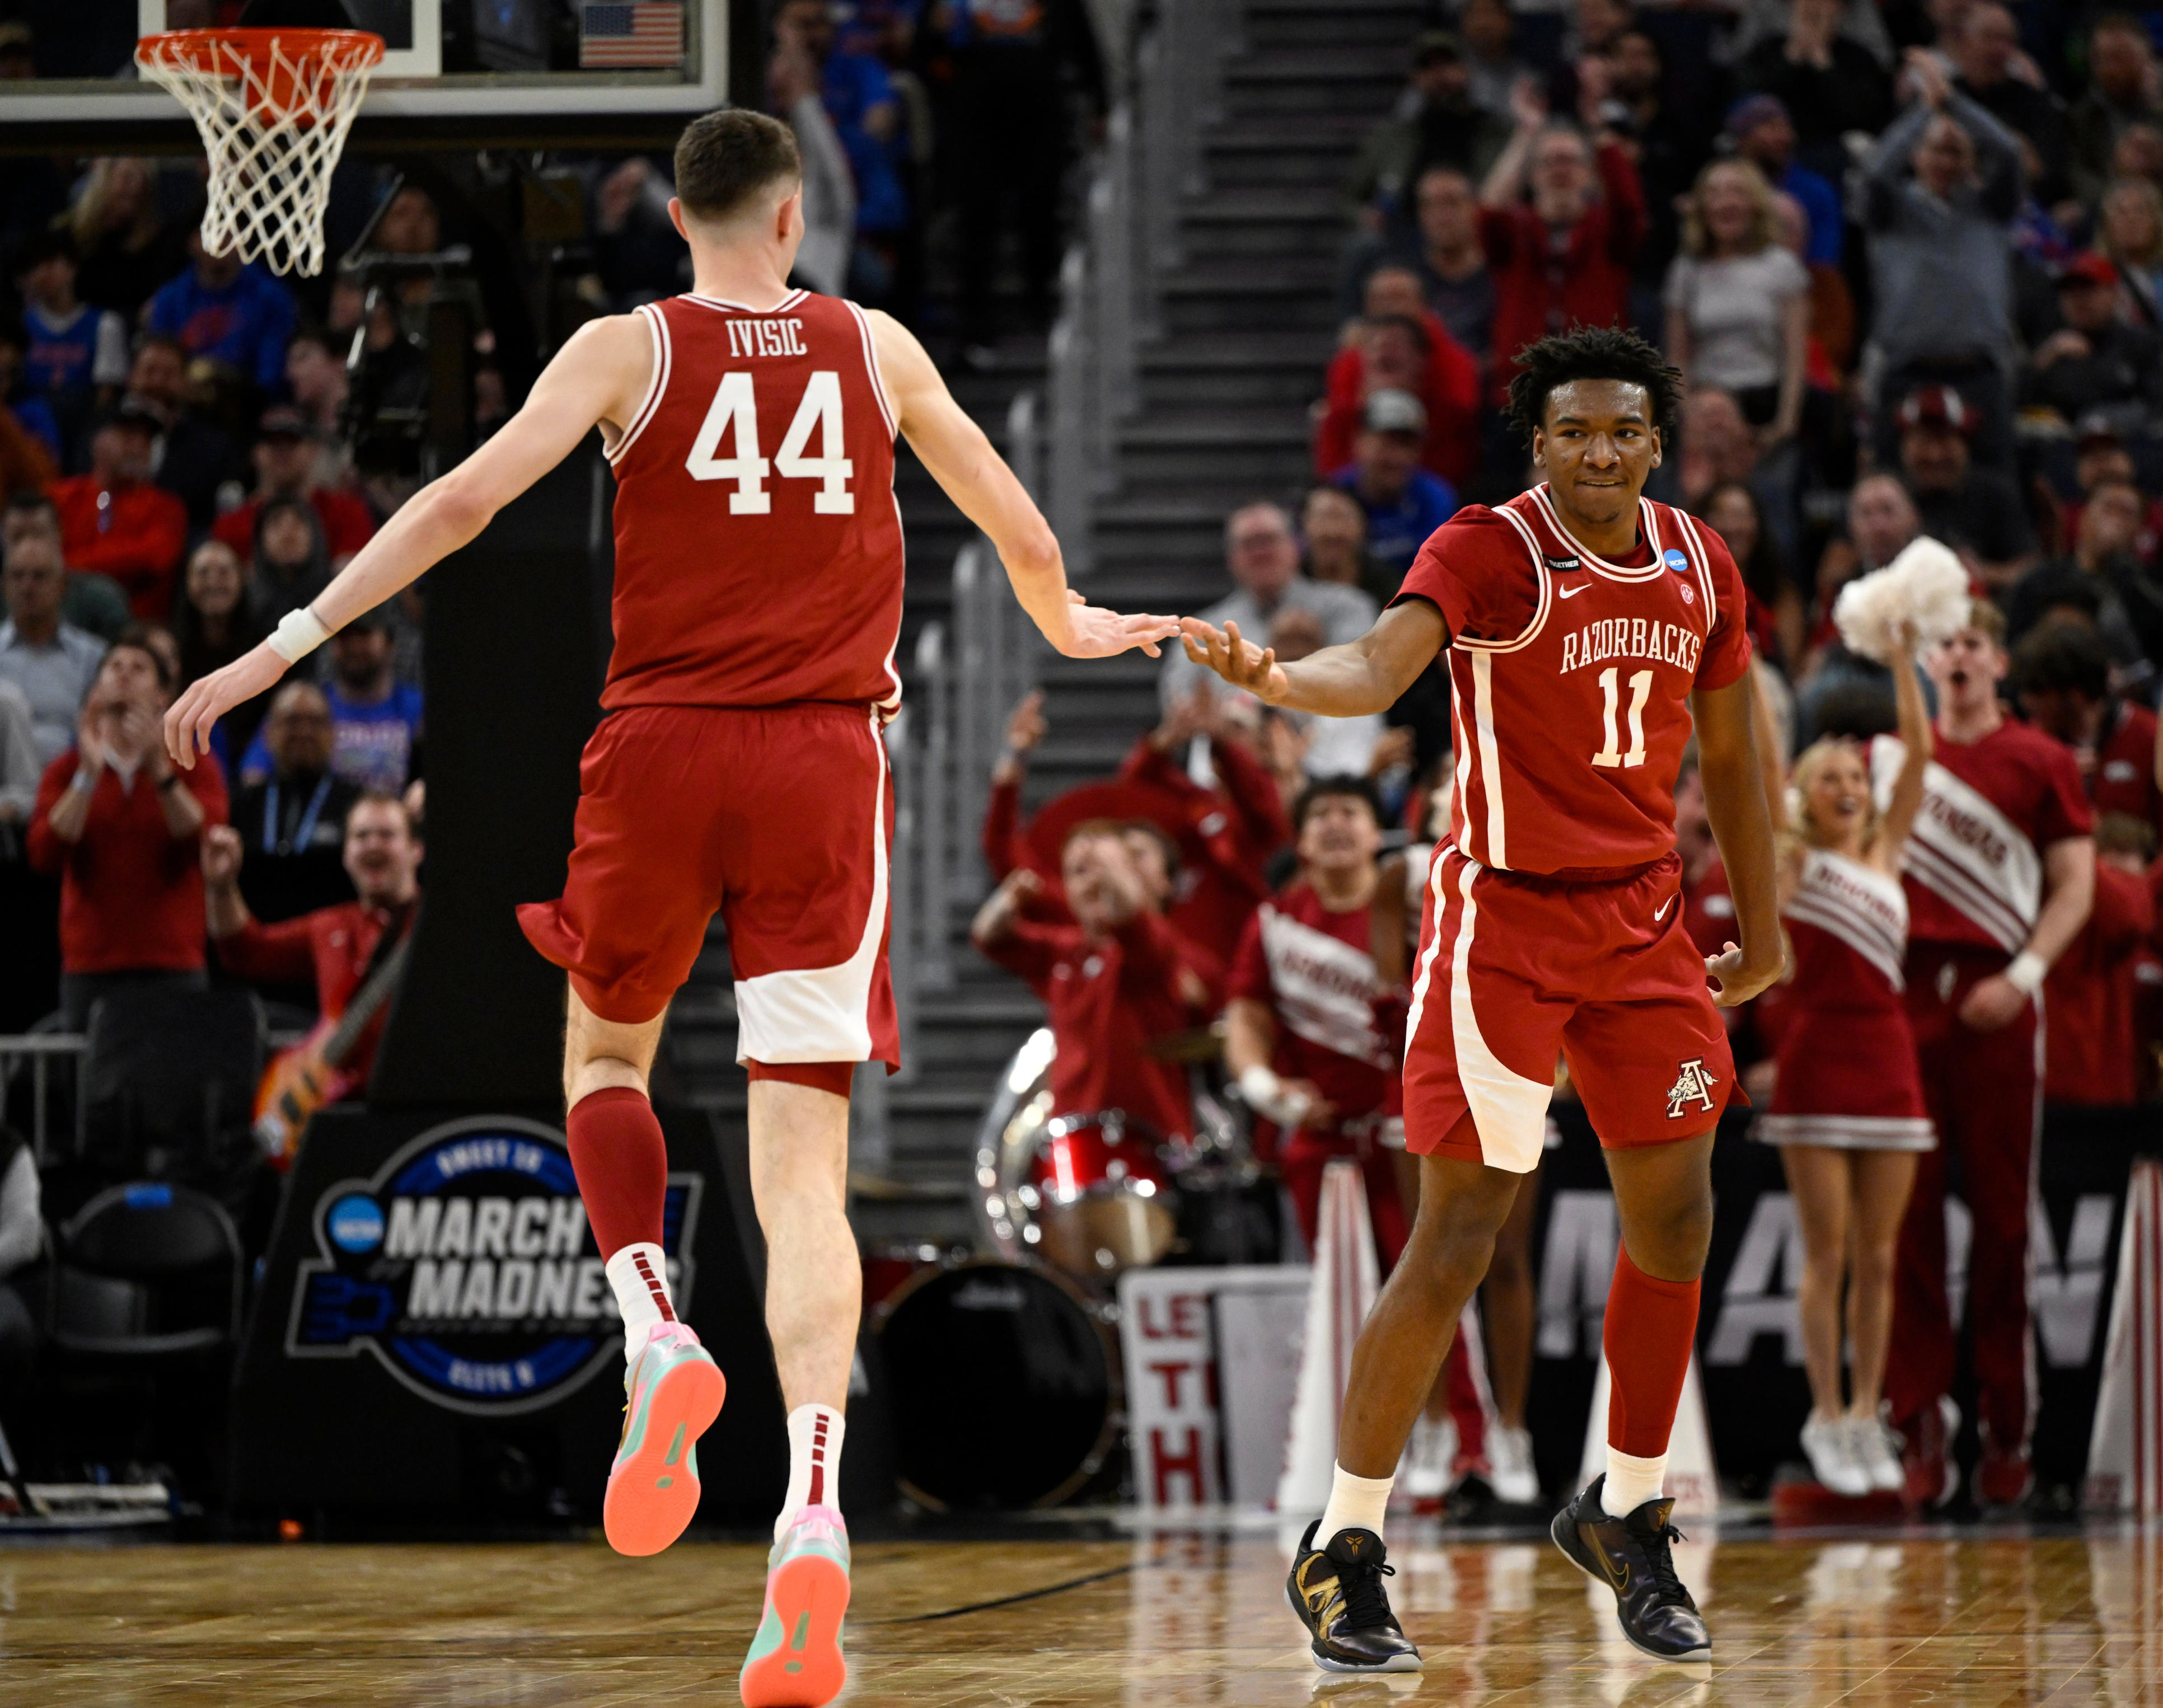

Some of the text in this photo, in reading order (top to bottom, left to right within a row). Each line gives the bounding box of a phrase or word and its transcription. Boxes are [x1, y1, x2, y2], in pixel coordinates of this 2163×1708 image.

[725, 318, 807, 358] IVISIC
[685, 370, 855, 515] 44
[1669, 558, 1687, 566] NCAA
[1560, 618, 1701, 674] RAZORBACKS
[1590, 668, 1654, 768] 11
[386, 1197, 587, 1257] MARCH
[406, 1259, 681, 1319] MADNE
